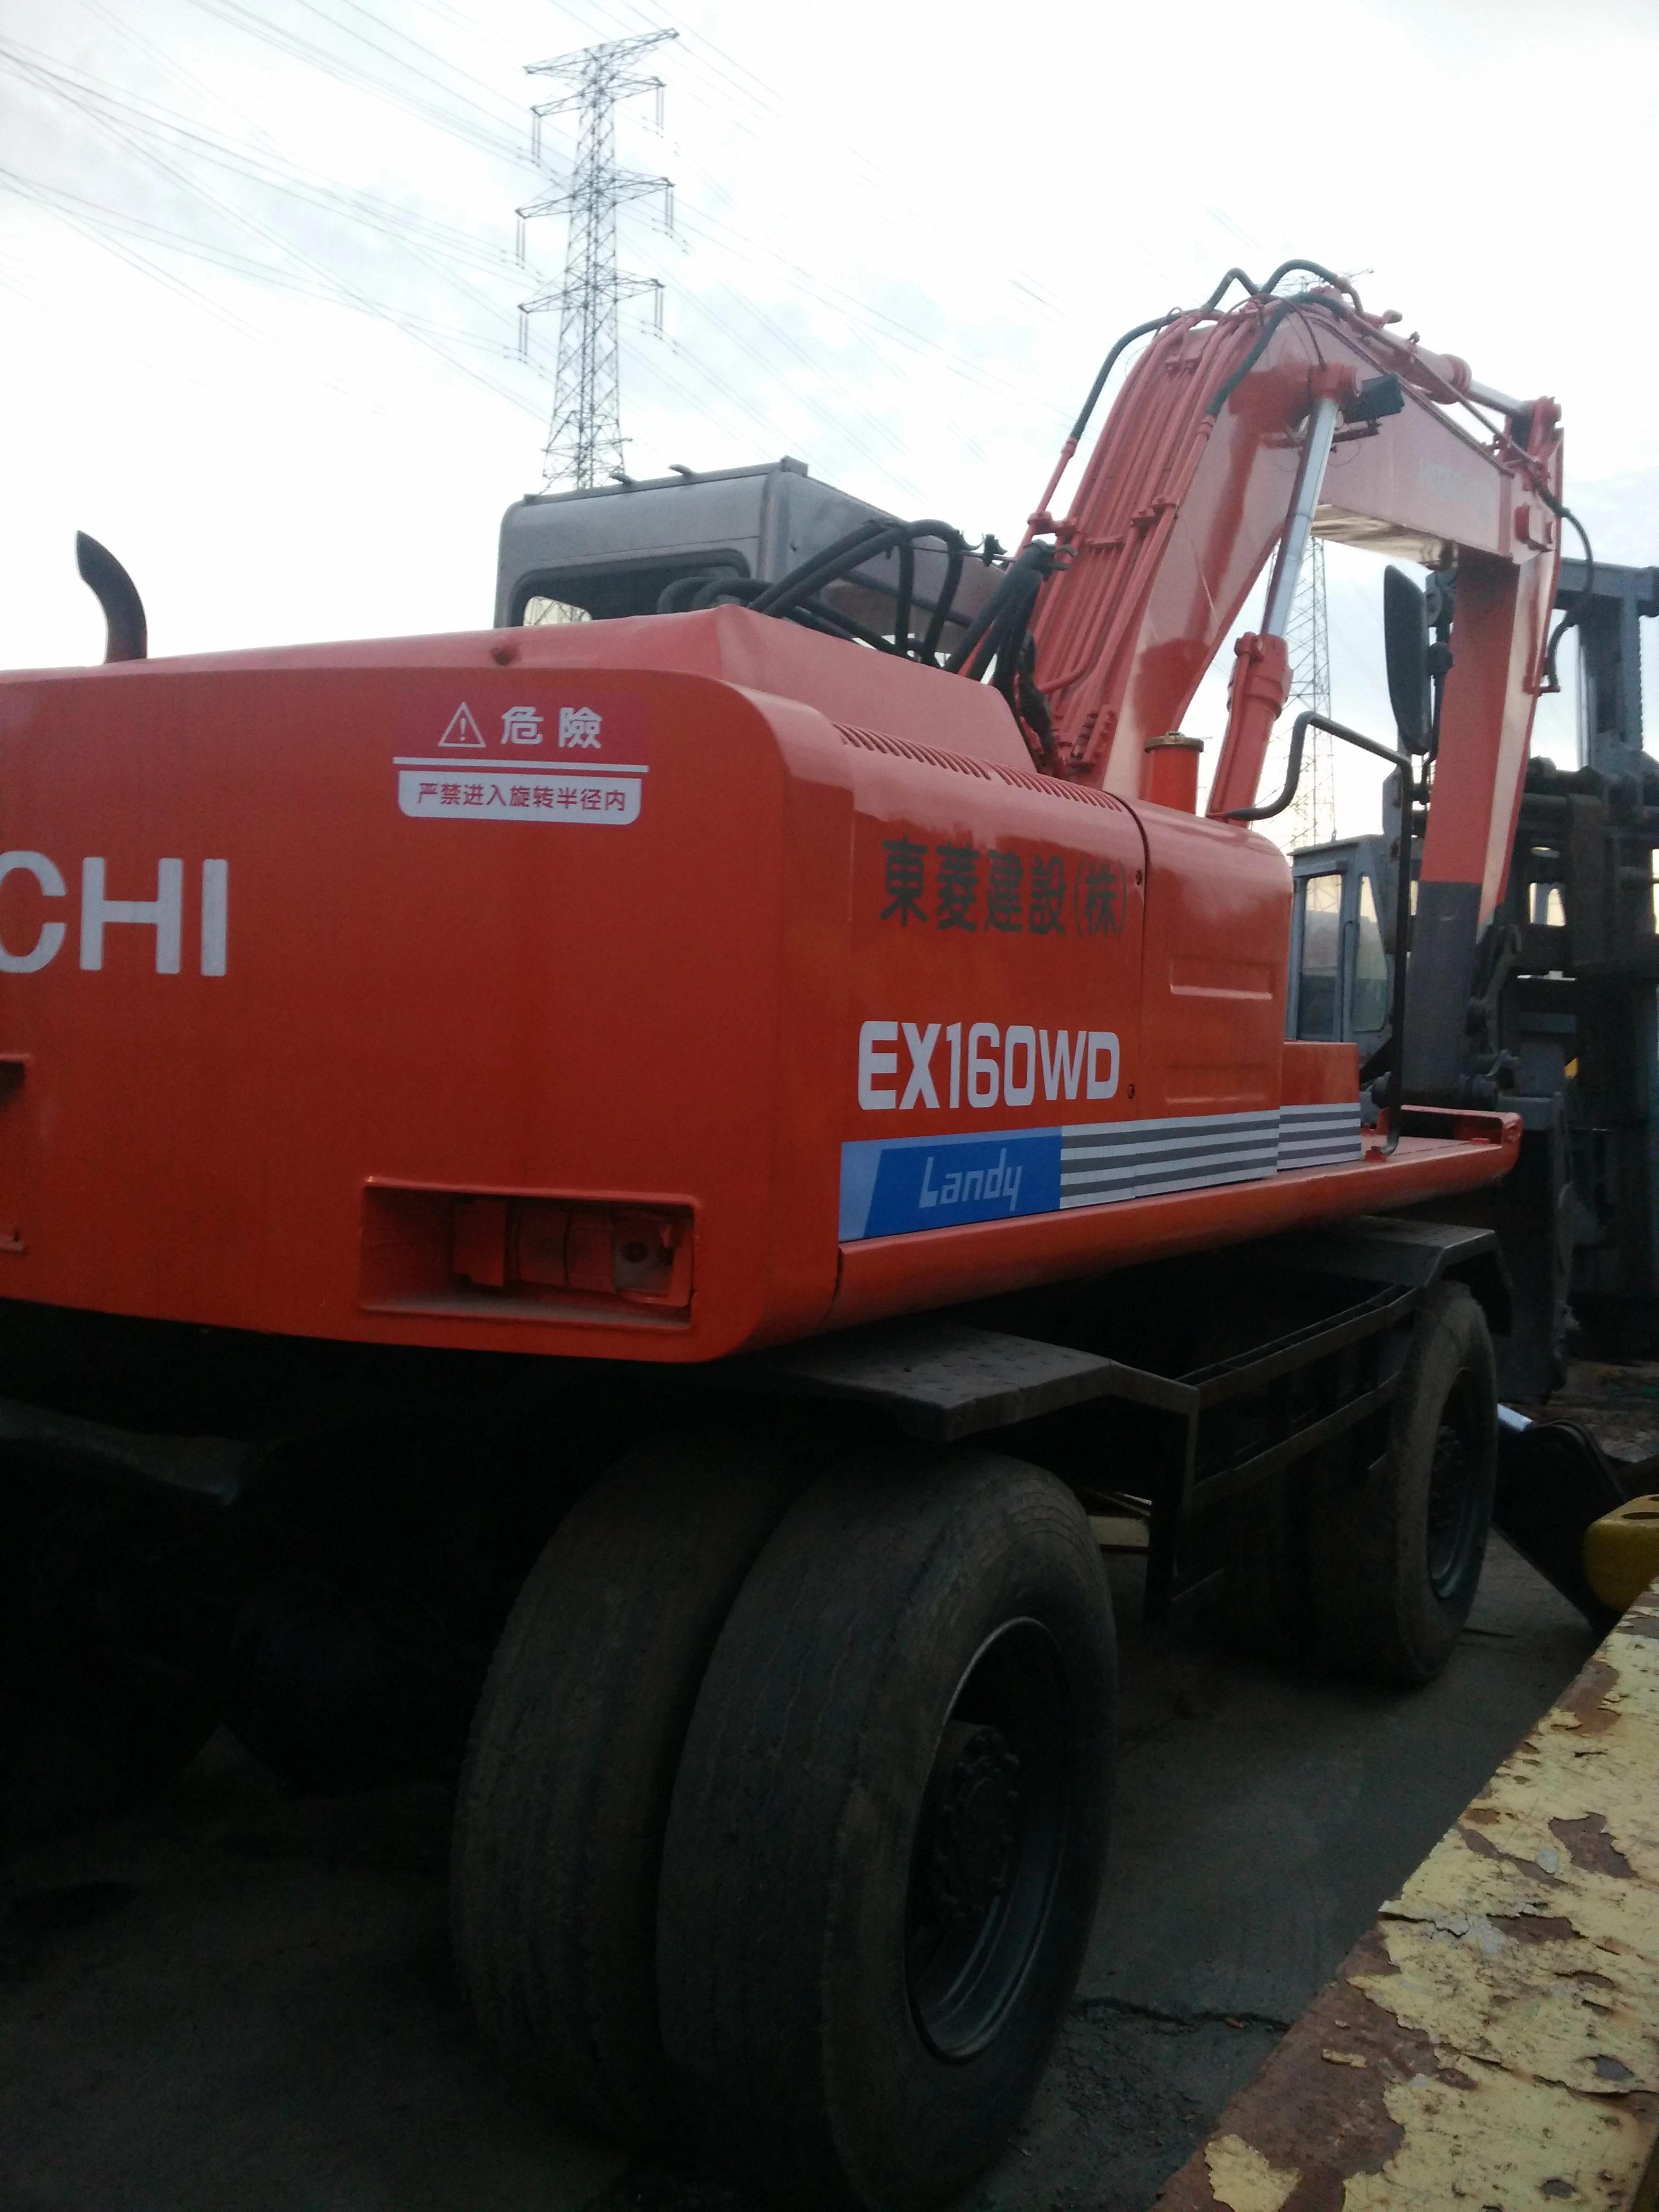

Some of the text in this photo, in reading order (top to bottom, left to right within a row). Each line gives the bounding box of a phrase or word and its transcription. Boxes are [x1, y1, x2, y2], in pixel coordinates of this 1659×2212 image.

[500, 706, 603, 749] 危險
[417, 782, 626, 812] 严禁进入旋转半径内
[0, 850, 229, 977] CHI
[858, 1020, 1120, 1111] EX160WD
[918, 1147, 1023, 1212] Landy
